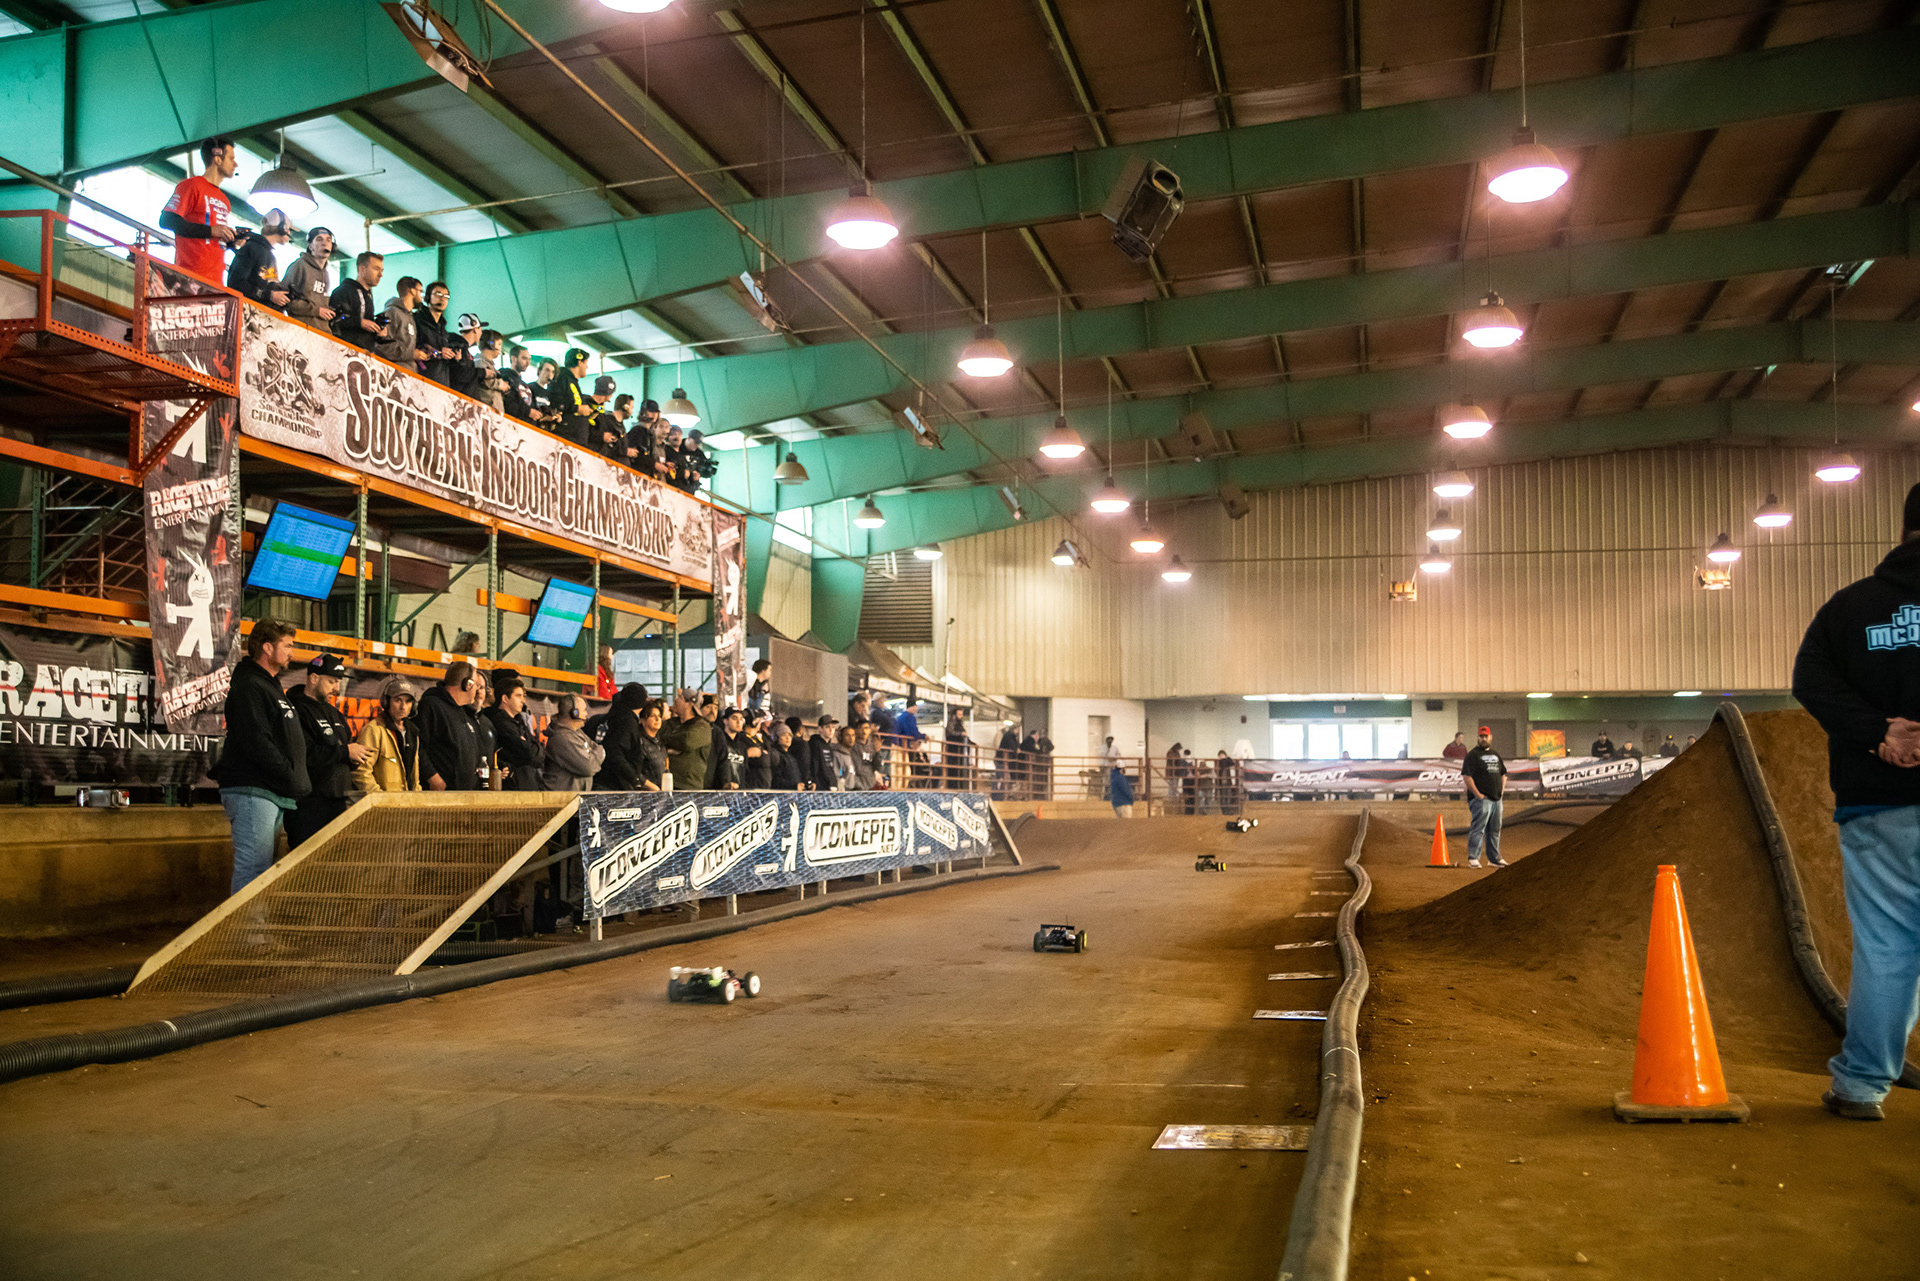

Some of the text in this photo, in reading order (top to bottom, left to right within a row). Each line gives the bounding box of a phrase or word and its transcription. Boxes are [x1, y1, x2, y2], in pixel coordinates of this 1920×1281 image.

[155, 326, 227, 342] ENTERTAINMENT
[250, 408, 324, 439] CHAMPIONSHIP
[167, 690, 228, 725] ENTERTAINMEN
[0, 720, 219, 753] ENTERTAINMENT
[809, 817, 896, 851] JCONCEPTS
